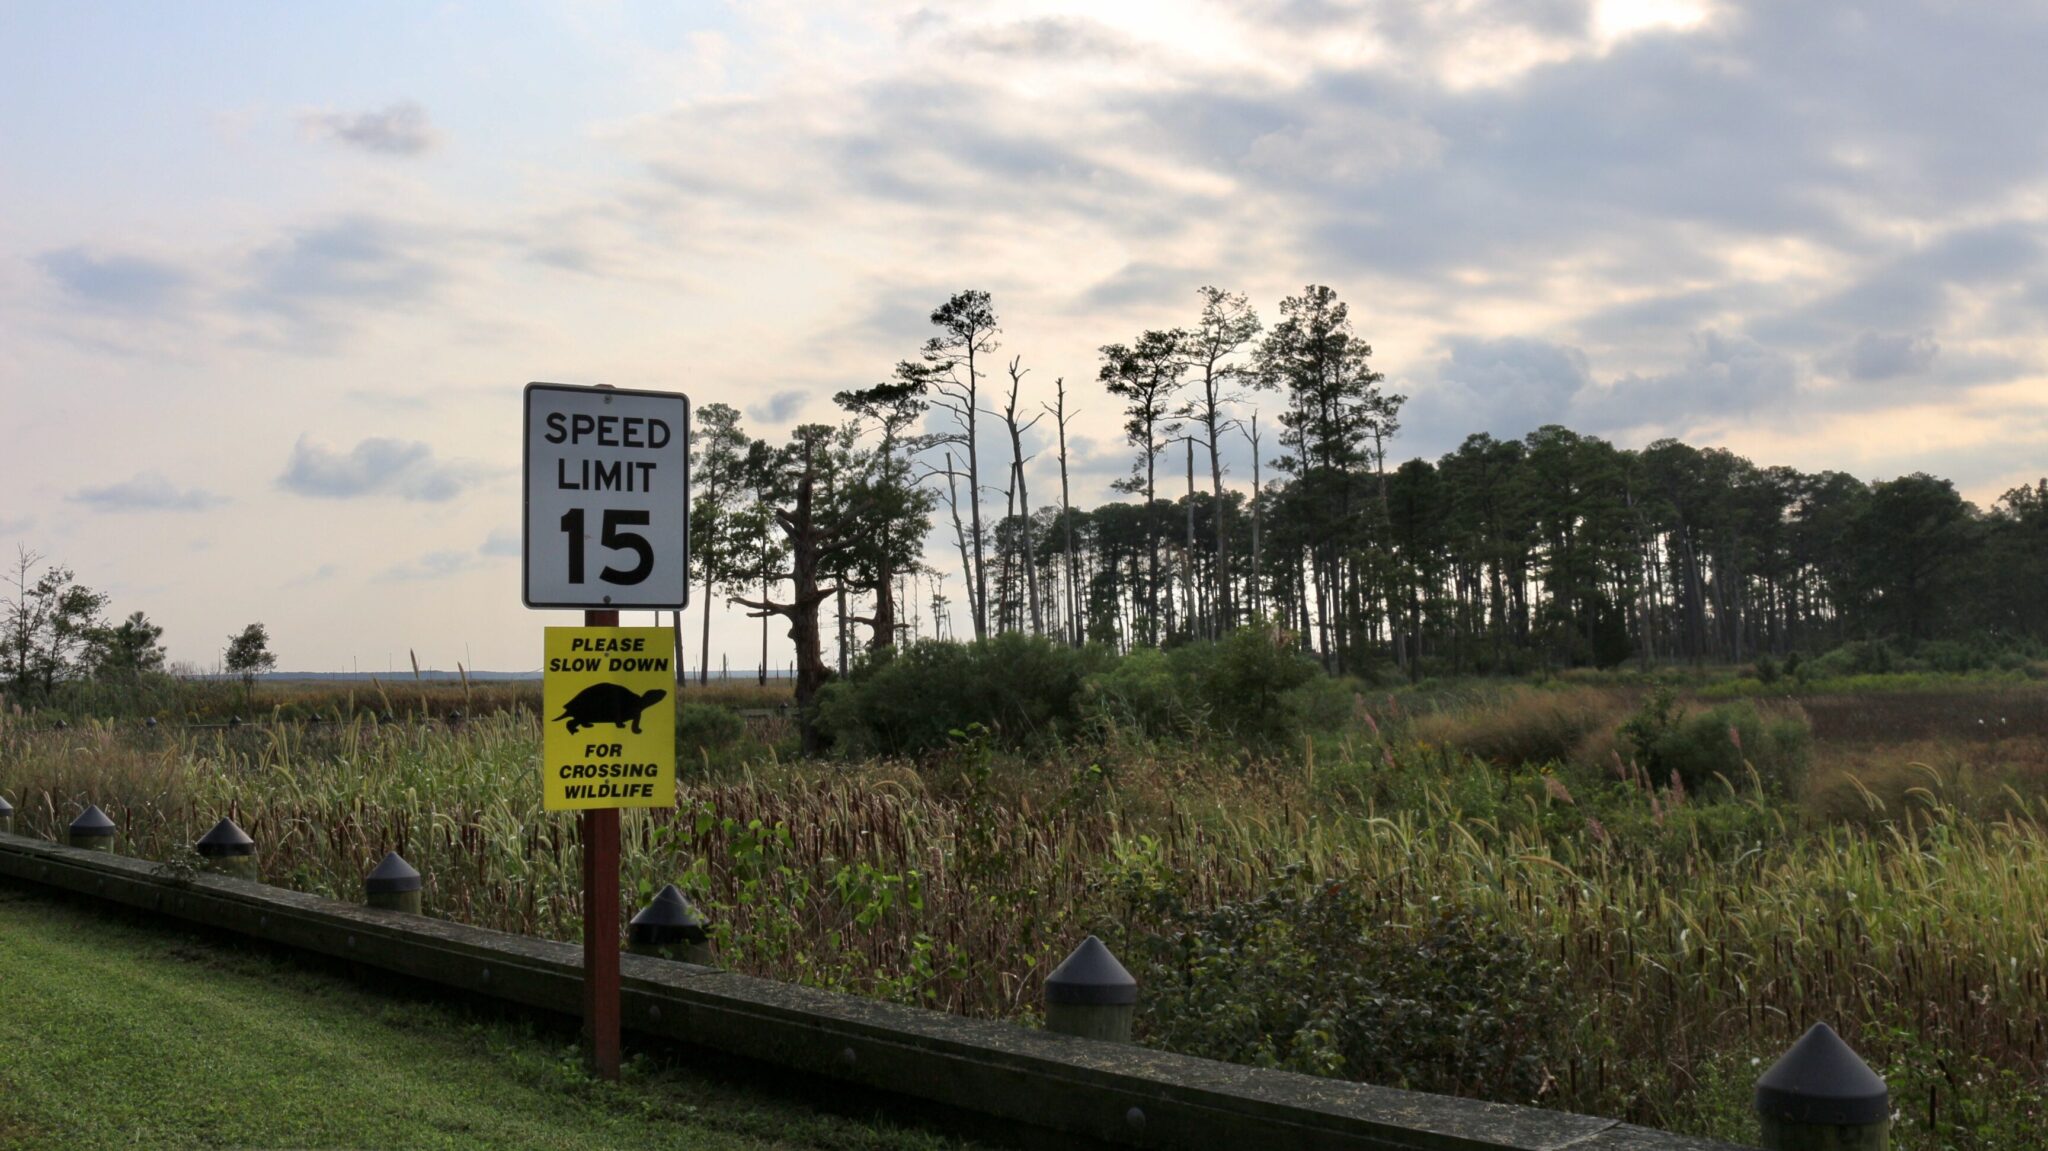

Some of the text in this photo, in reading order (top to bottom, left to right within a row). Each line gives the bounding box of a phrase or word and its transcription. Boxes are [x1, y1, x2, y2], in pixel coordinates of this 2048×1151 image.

[544, 412, 671, 449] SPEED
[558, 458, 657, 493] LIMIT
[560, 508, 655, 586] 15
[571, 637, 646, 652] PLEASE
[549, 658, 669, 672] SLOW DOWN
[584, 744, 623, 758] FOR
[559, 763, 659, 779] CROSSING
[564, 783, 654, 799] WILDLIFE
